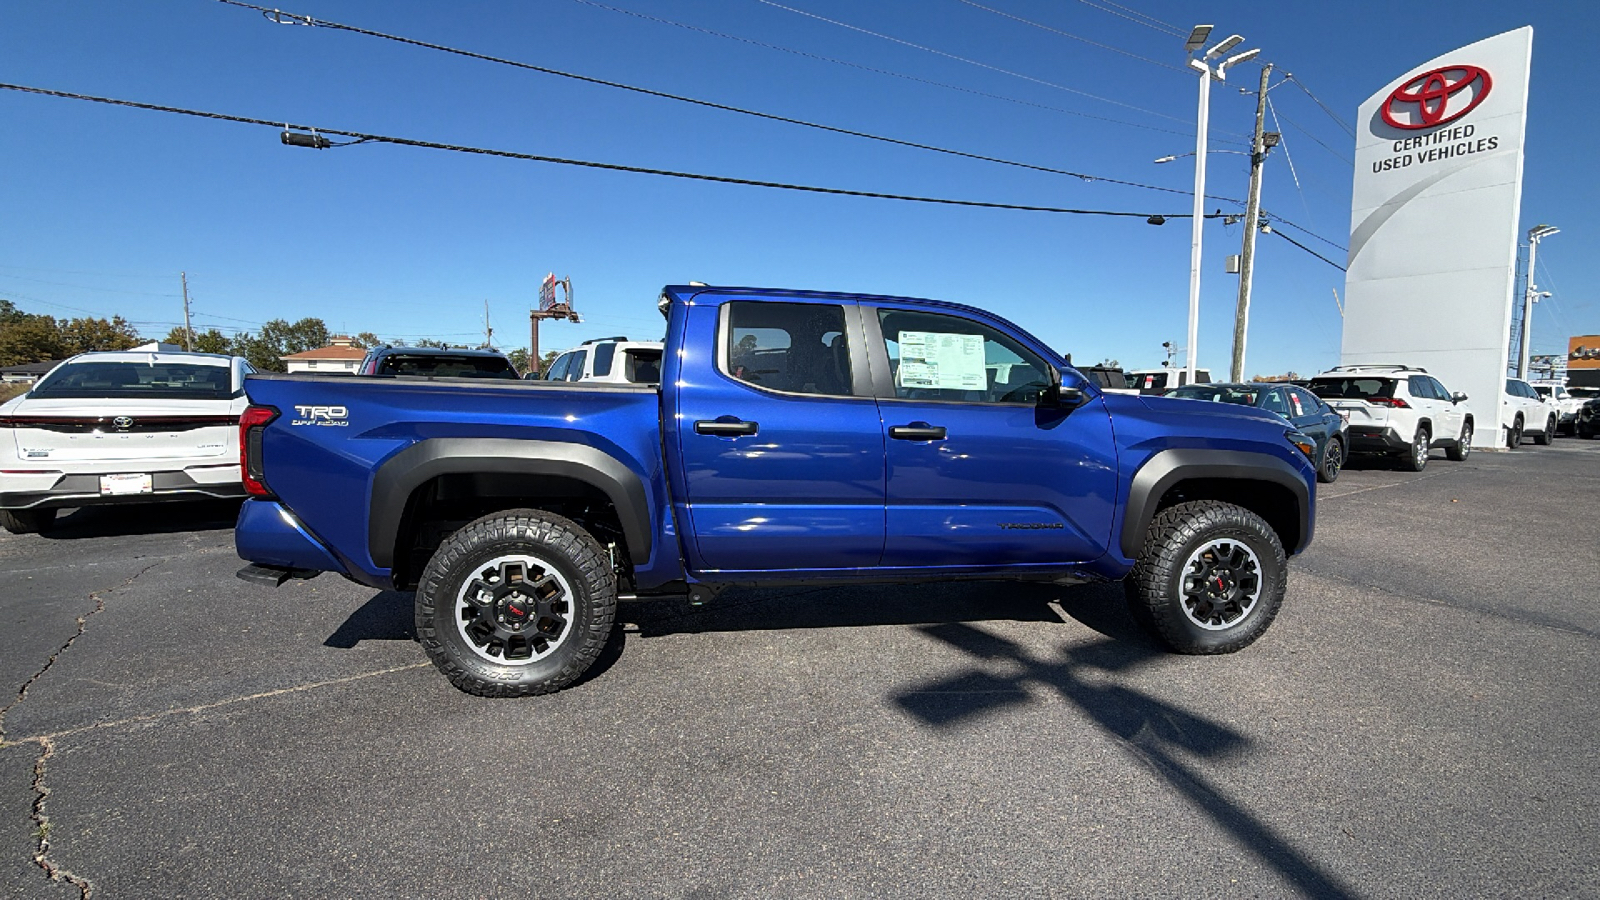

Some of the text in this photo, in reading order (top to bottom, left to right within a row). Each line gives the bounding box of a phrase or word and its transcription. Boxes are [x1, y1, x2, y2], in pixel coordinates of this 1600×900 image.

[1393, 124, 1475, 153] CERTIFIED
[1372, 136, 1498, 173] USED VEHICLES
[1571, 345, 1600, 358] Je
[294, 405, 349, 420] TRD
